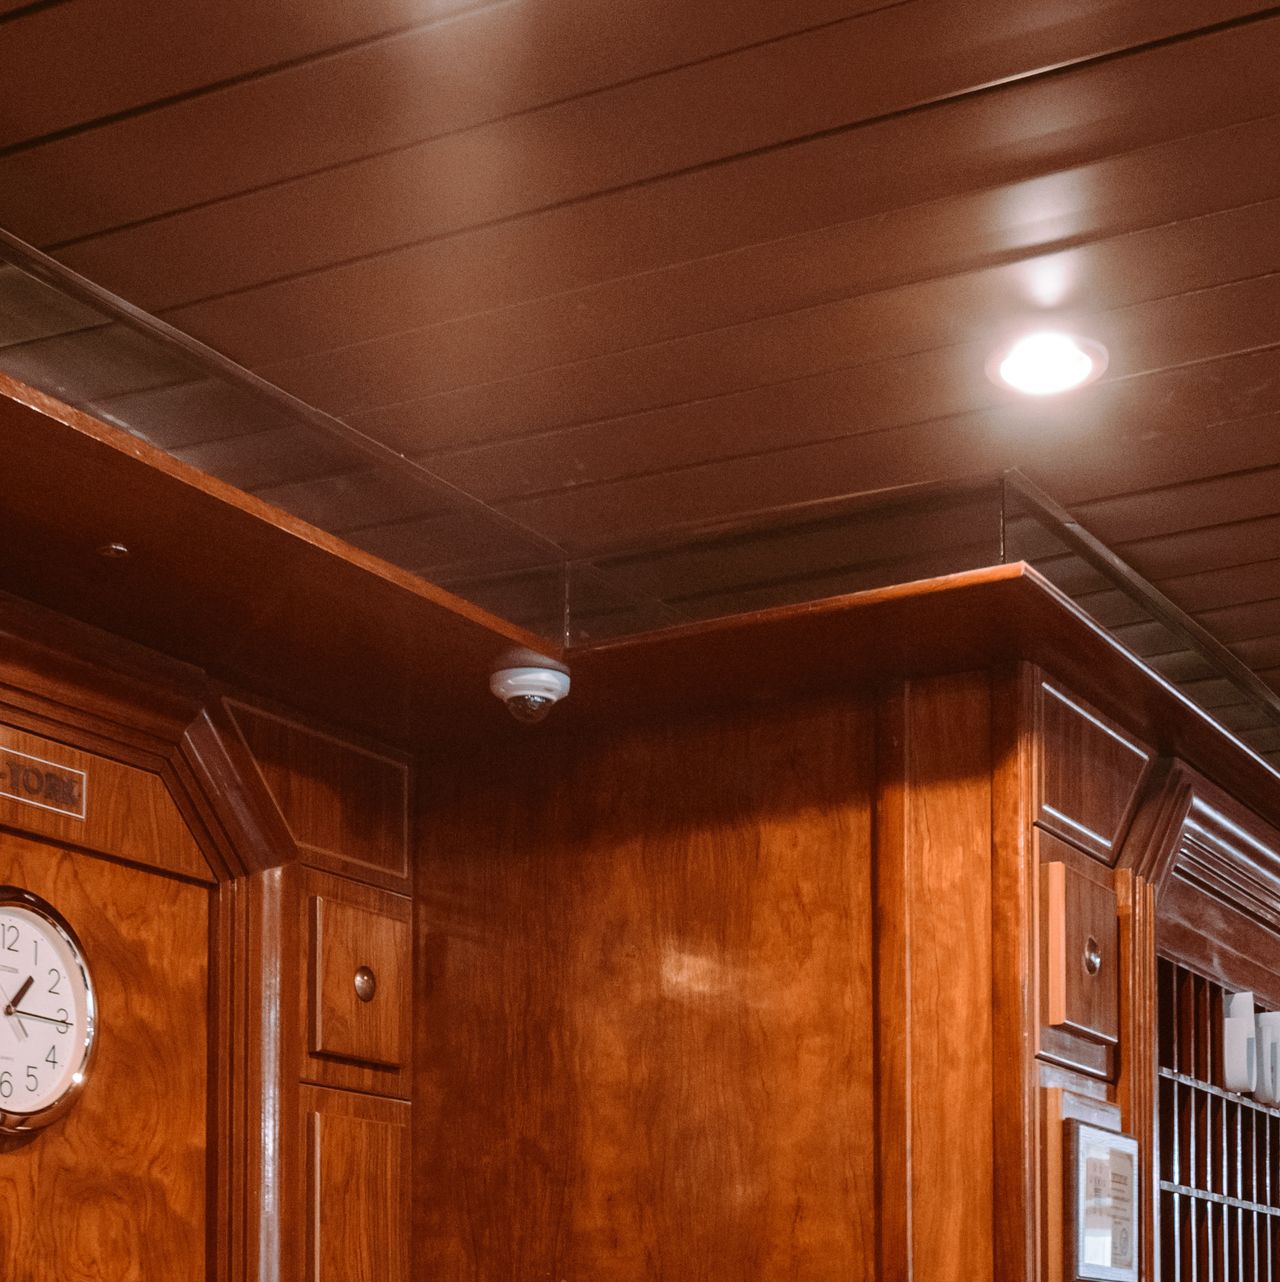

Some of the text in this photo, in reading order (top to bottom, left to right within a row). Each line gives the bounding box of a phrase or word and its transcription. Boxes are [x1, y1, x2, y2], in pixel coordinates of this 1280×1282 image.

[0, 923, 20, 953] 12
[33, 940, 39, 966] 1
[48, 968, 61, 995] 2
[55, 1008, 69, 1034] 3
[45, 1045, 59, 1070] 4
[0, 1071, 13, 1098] 6
[25, 1066, 39, 1092] 5
